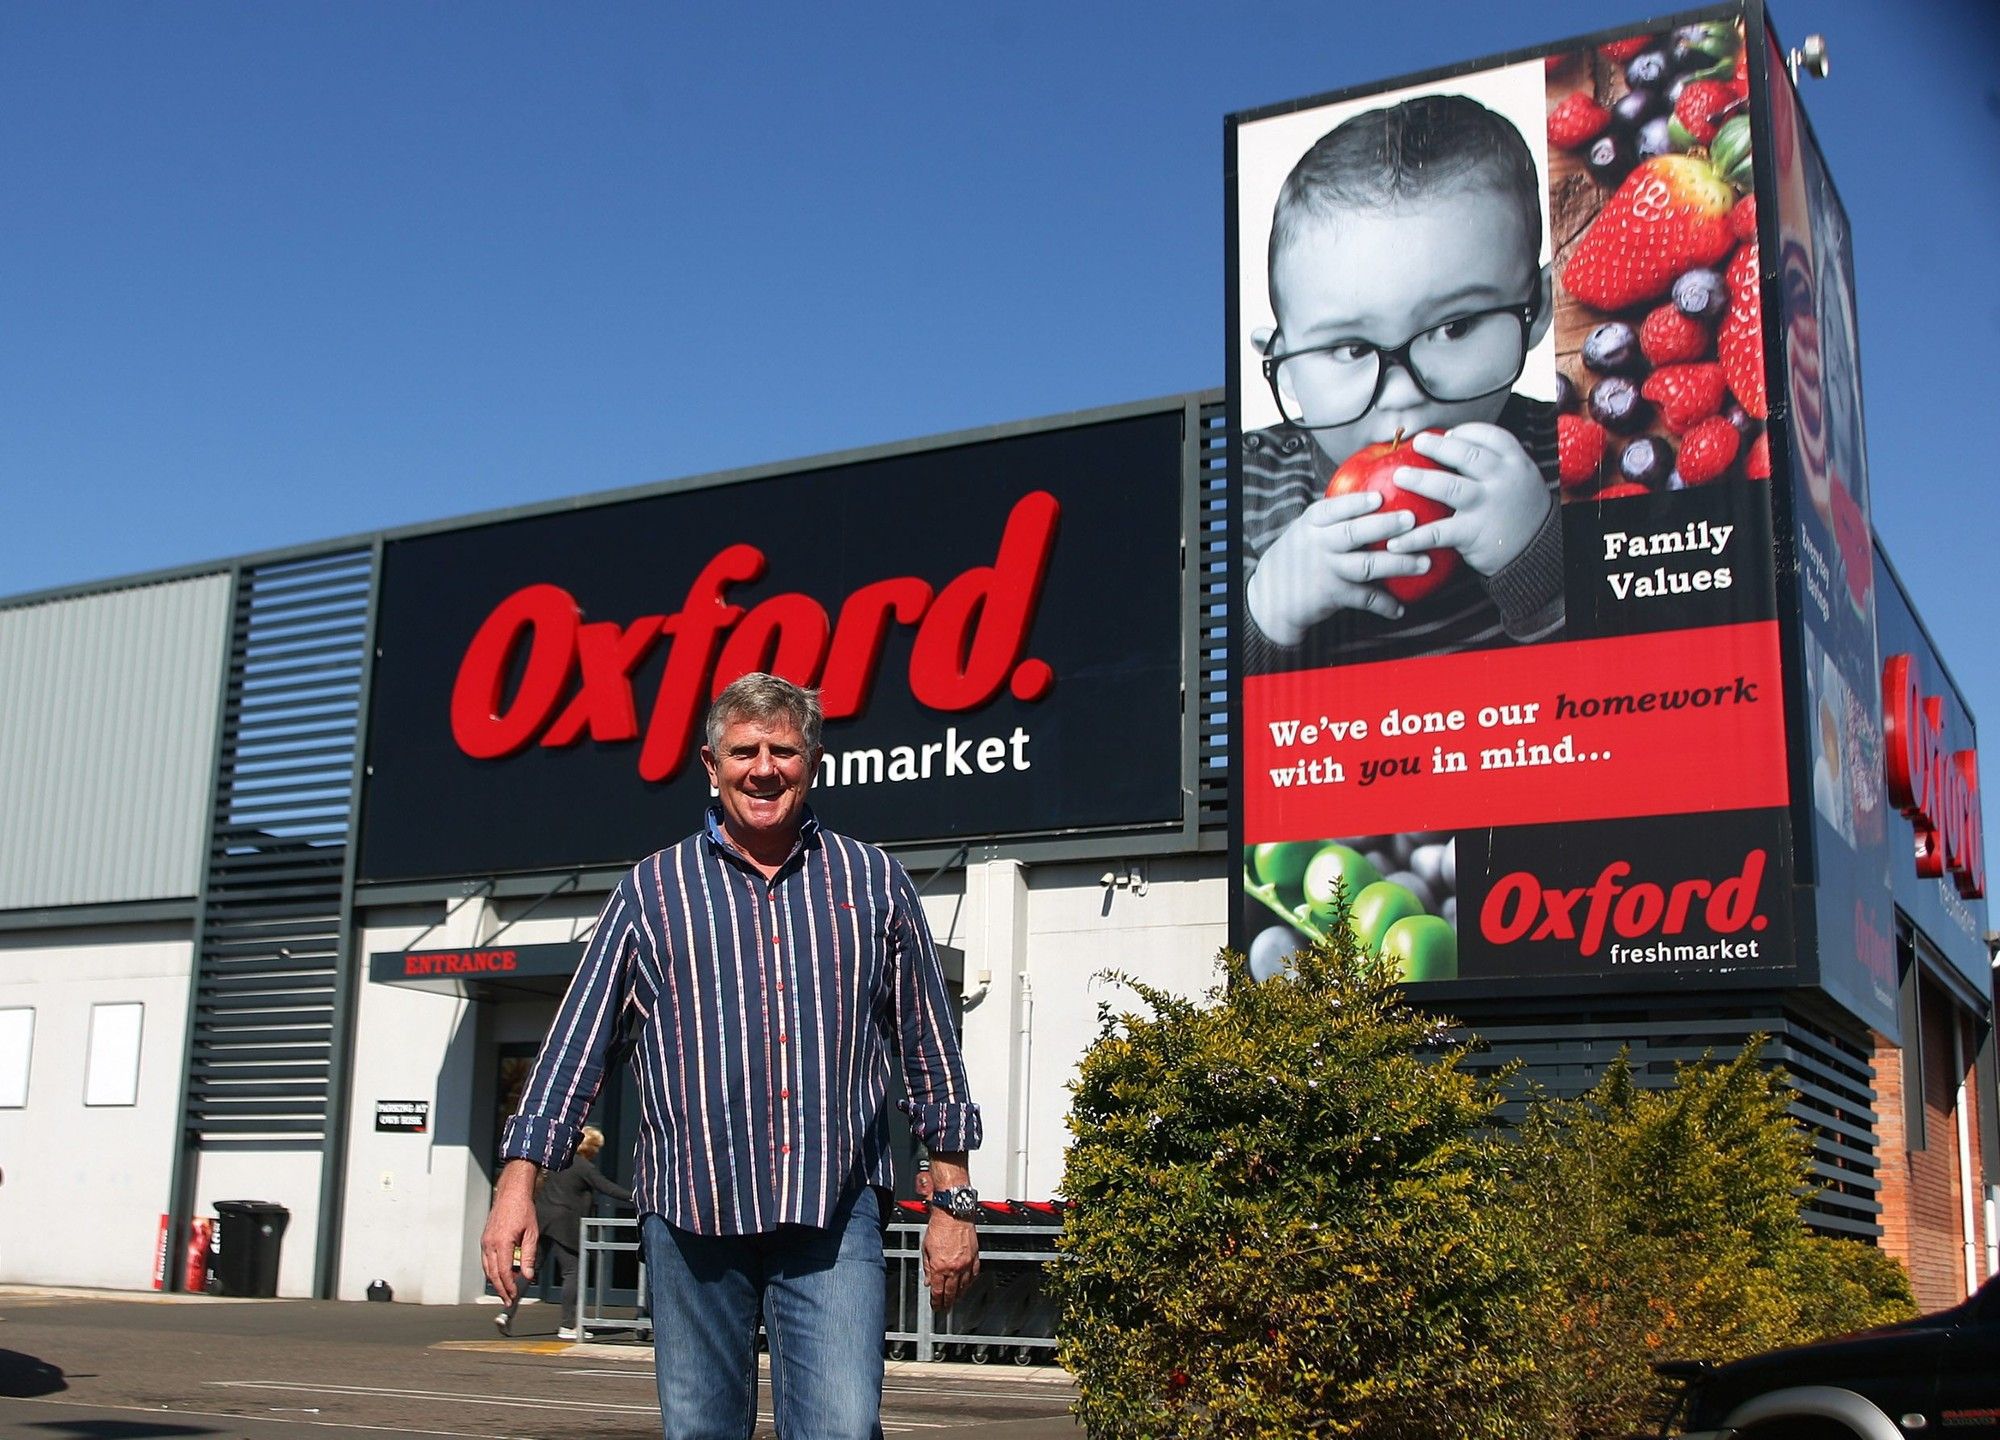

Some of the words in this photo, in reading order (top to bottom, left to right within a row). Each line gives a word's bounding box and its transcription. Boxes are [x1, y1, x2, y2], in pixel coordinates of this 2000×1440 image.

[1603, 520, 1734, 561] Family
[1606, 566, 1733, 600] Values
[1268, 715, 1368, 748] We've
[1380, 709, 1466, 737] done
[1477, 702, 1540, 728] our
[1555, 676, 1759, 720] homework
[710, 727, 1031, 797] market
[1269, 756, 1346, 788] with
[1358, 756, 1421, 786] you
[1432, 746, 1468, 774] in
[1480, 734, 1612, 770] mind...
[404, 950, 517, 976] ENTRANCE
[1610, 938, 1760, 964] freshmarket
